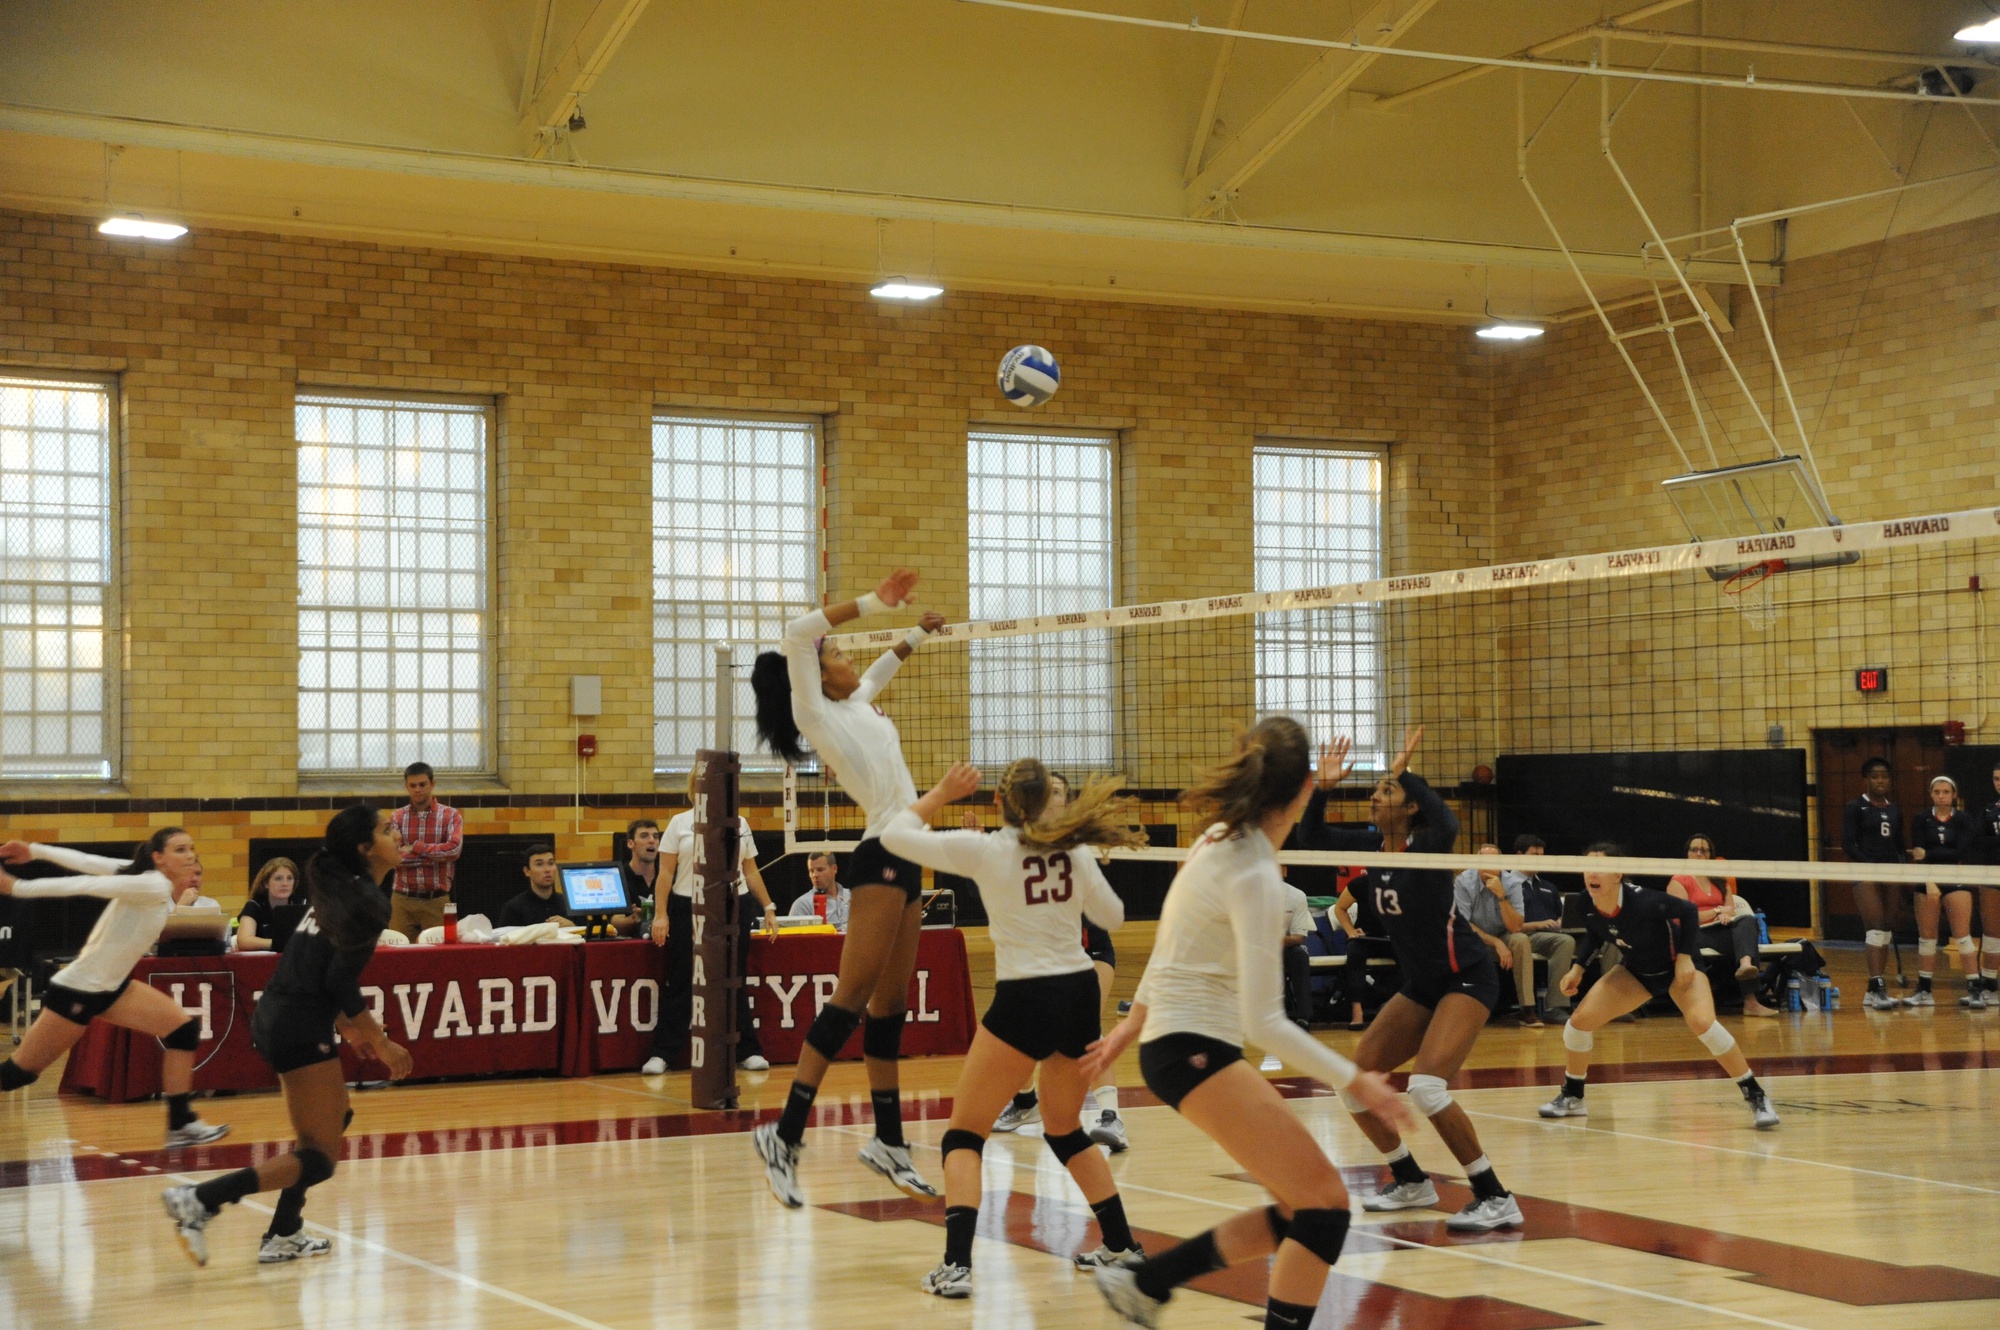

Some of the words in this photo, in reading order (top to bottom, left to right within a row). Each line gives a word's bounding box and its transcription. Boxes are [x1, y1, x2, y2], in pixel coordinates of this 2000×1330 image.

[1388, 576, 1431, 592] HARVARD
[1736, 534, 1796, 554] HARVARD
[1883, 517, 1950, 538] HARVARD
[1861, 671, 1878, 689] EXIT
[1881, 822, 1890, 836] 6
[1022, 851, 1073, 905] 23
[1375, 887, 1403, 915] 13
[692, 793, 708, 1069] HARVARD
